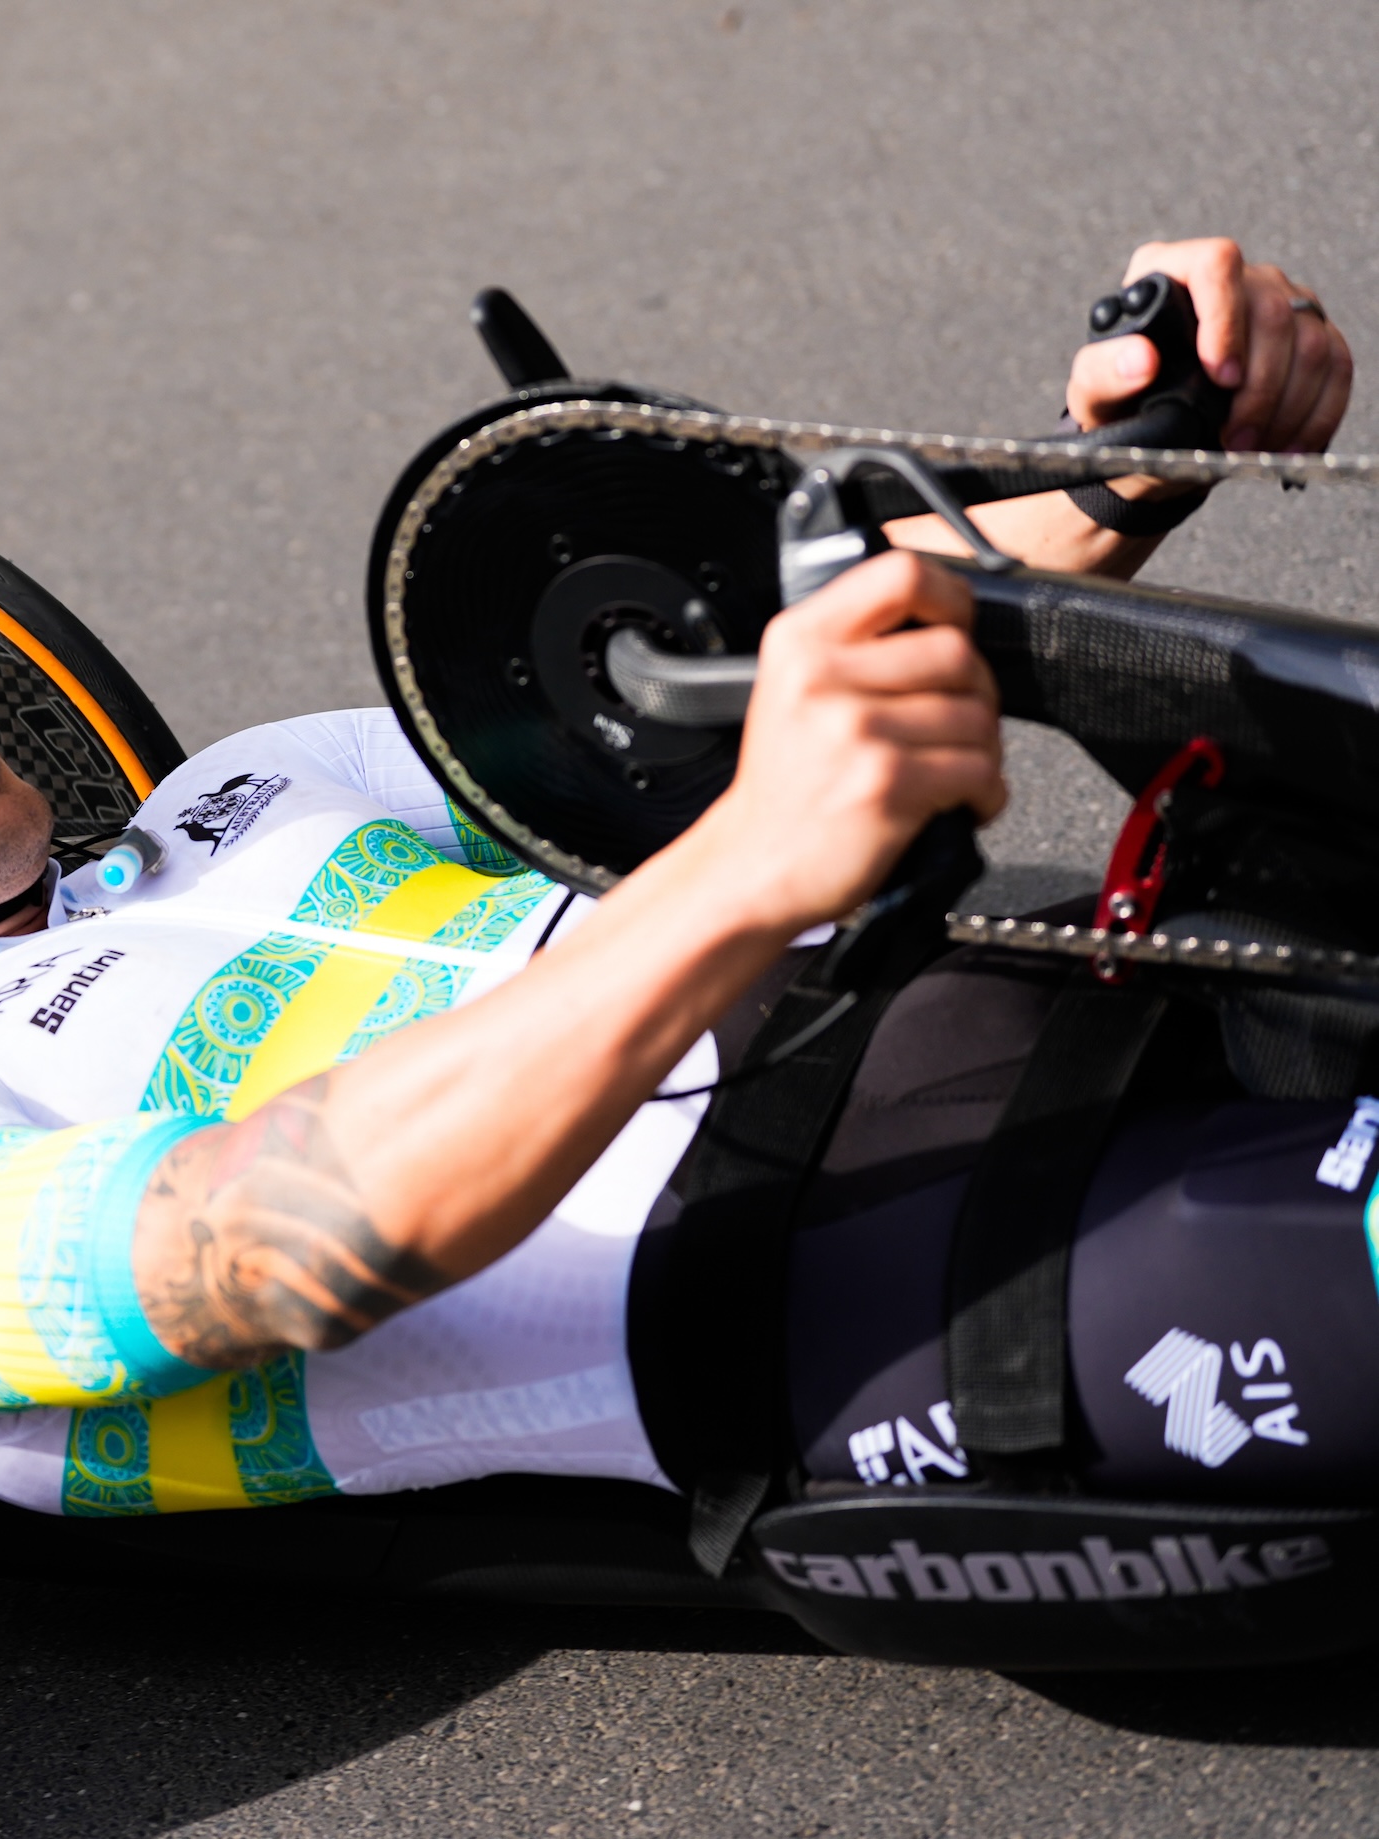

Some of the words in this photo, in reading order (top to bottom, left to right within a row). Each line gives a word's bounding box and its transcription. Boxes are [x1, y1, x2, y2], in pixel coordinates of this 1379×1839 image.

[231, 783, 280, 831] AUSTRALIA
[30, 948, 126, 1035] Santini
[1229, 1337, 1310, 1447] AIS
